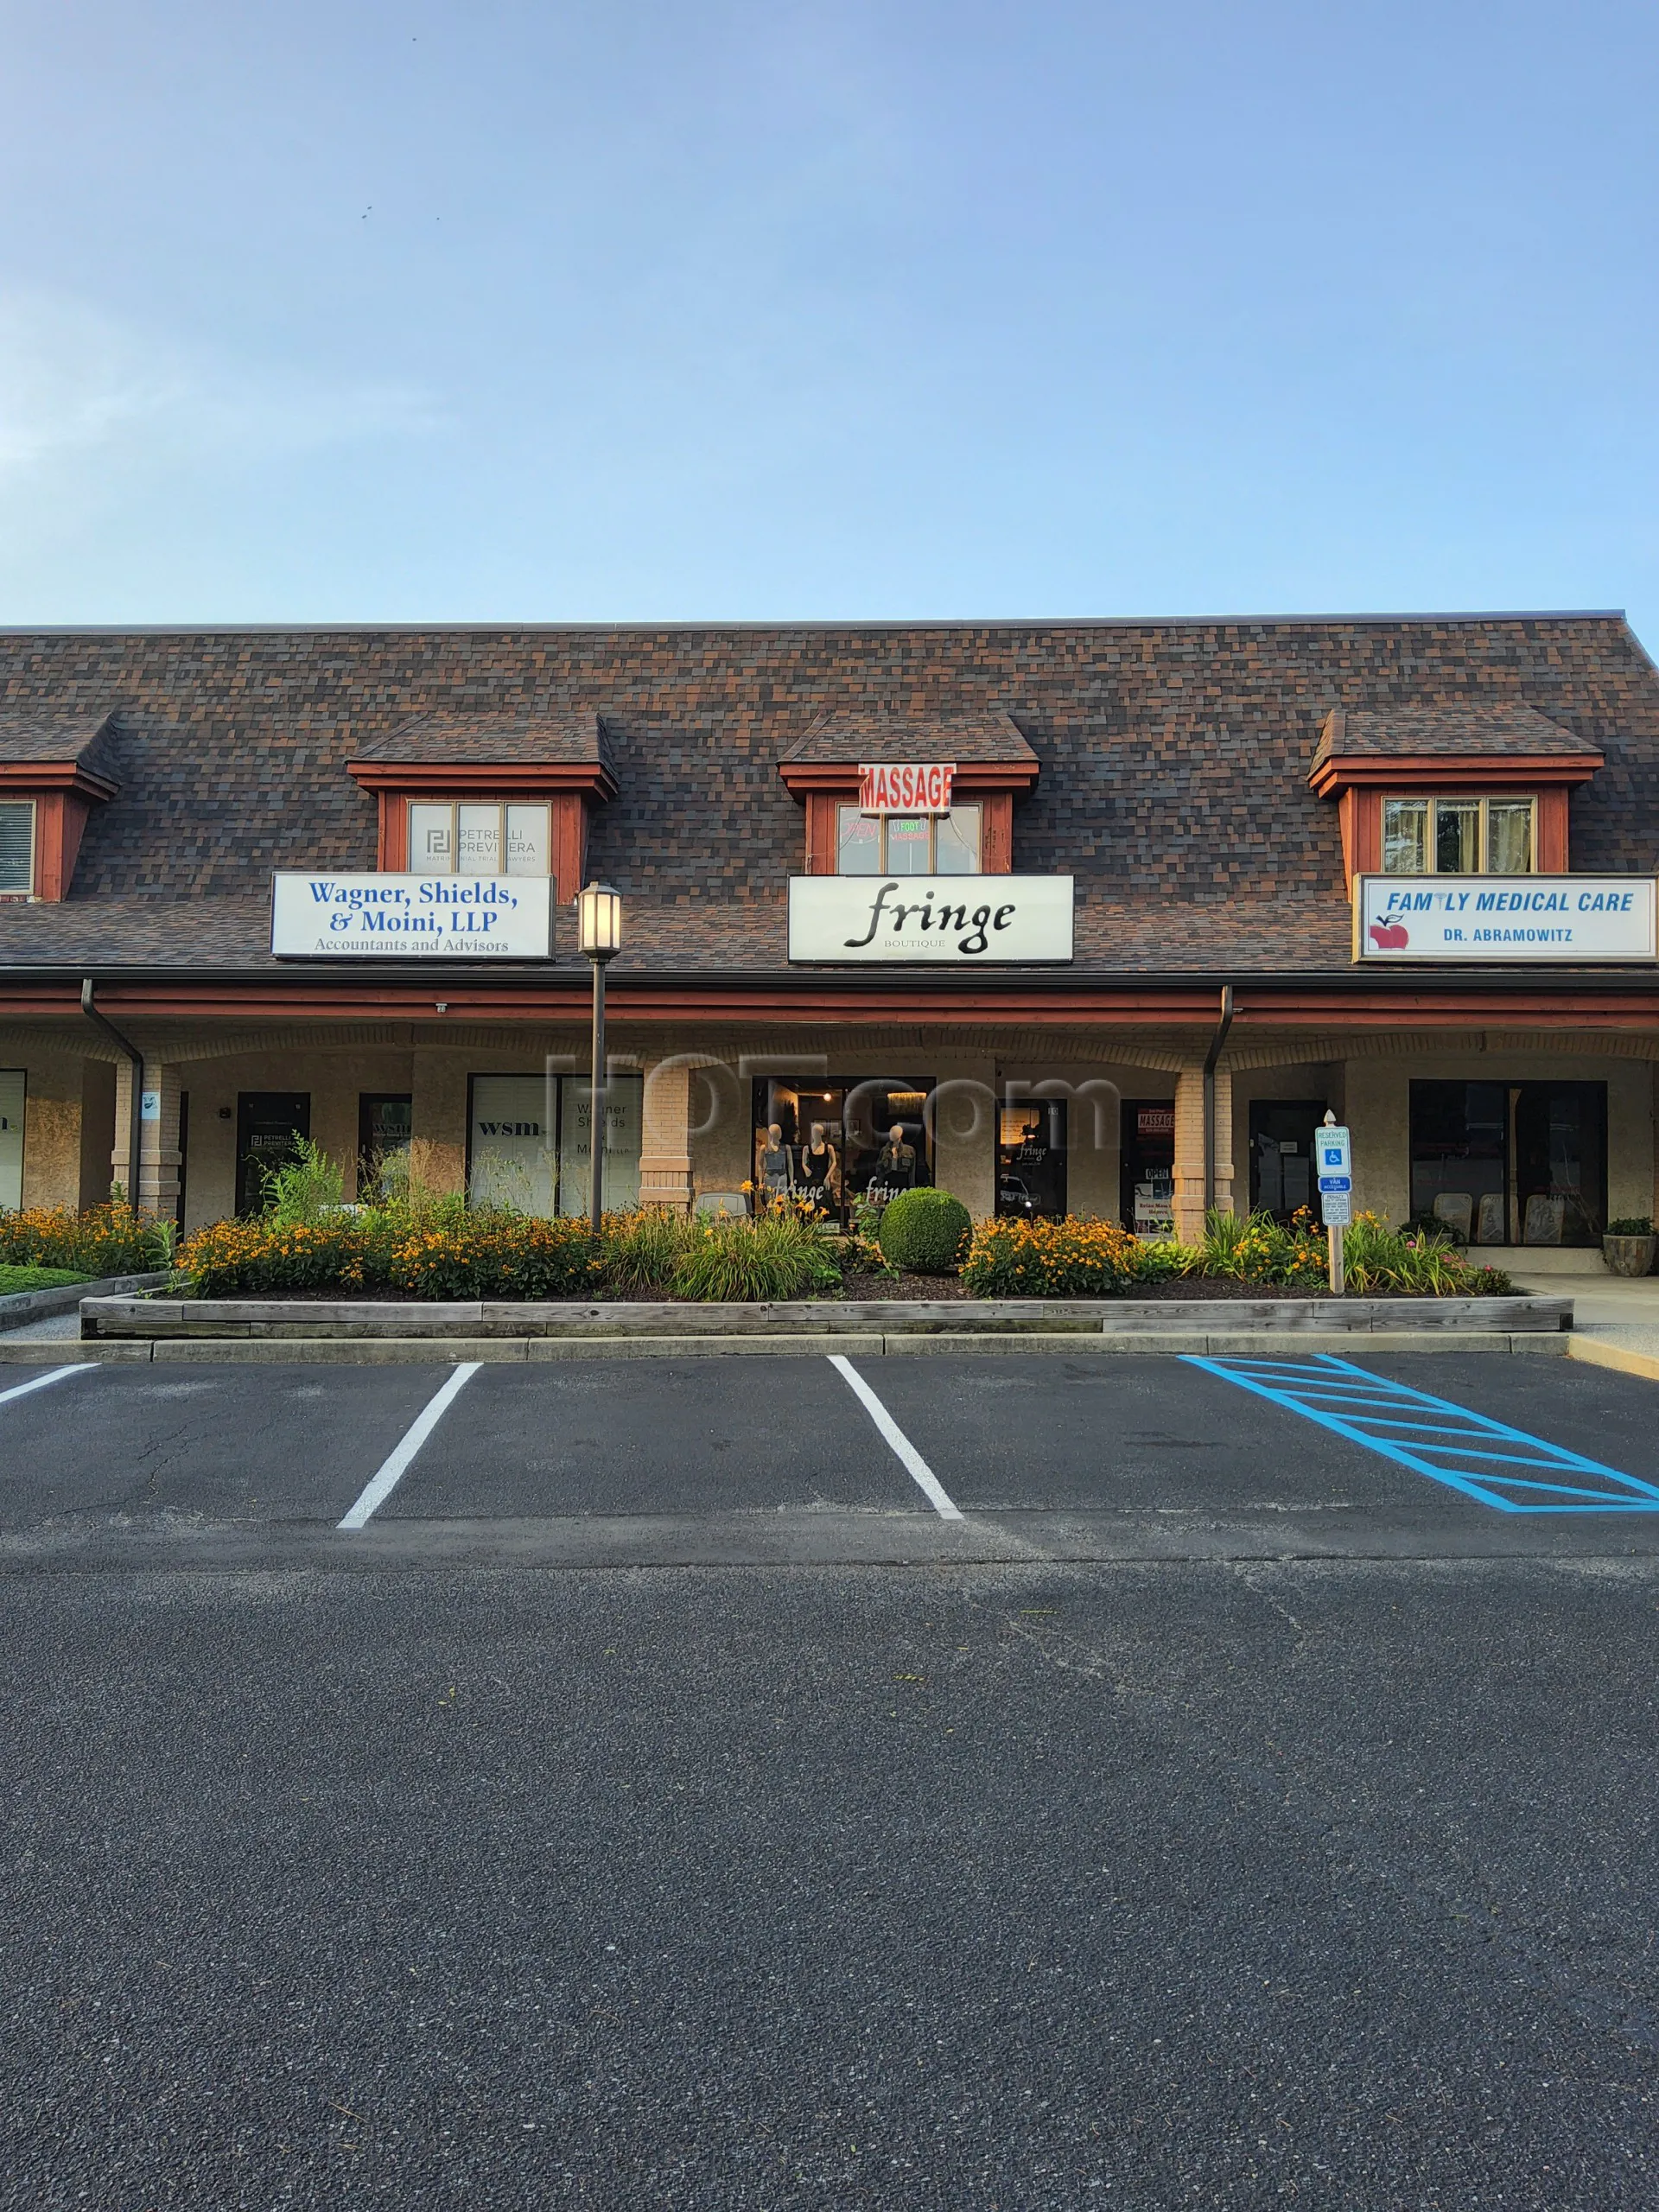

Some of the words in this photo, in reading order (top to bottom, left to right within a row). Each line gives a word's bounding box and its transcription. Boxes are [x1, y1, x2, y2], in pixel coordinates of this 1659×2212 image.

[860, 766, 954, 809] MASSAGE
[900, 821, 920, 832] FOOT
[459, 830, 523, 840] PETRELI
[459, 842, 536, 853] PREVIERA
[308, 882, 411, 910] Wagner,
[419, 881, 518, 910] Shields,
[1475, 892, 1570, 912] MEDICAL
[1578, 892, 1634, 912] CARE
[329, 912, 353, 931] &
[360, 911, 443, 938] Moini,
[450, 912, 498, 932] LLP
[842, 882, 1016, 955] fringe
[1443, 929, 1468, 942] DR.
[1472, 929, 1573, 942] ABRAMOWITZ
[314, 938, 407, 951] Accountants
[411, 938, 439, 951] and
[443, 938, 509, 952] Advisors
[1139, 1115, 1174, 1127] MASSAGE
[477, 1122, 540, 1136] wsm
[1016, 1142, 1047, 1161] fringe
[1147, 1169, 1167, 1178] OPEN
[866, 1176, 907, 1203] frin
